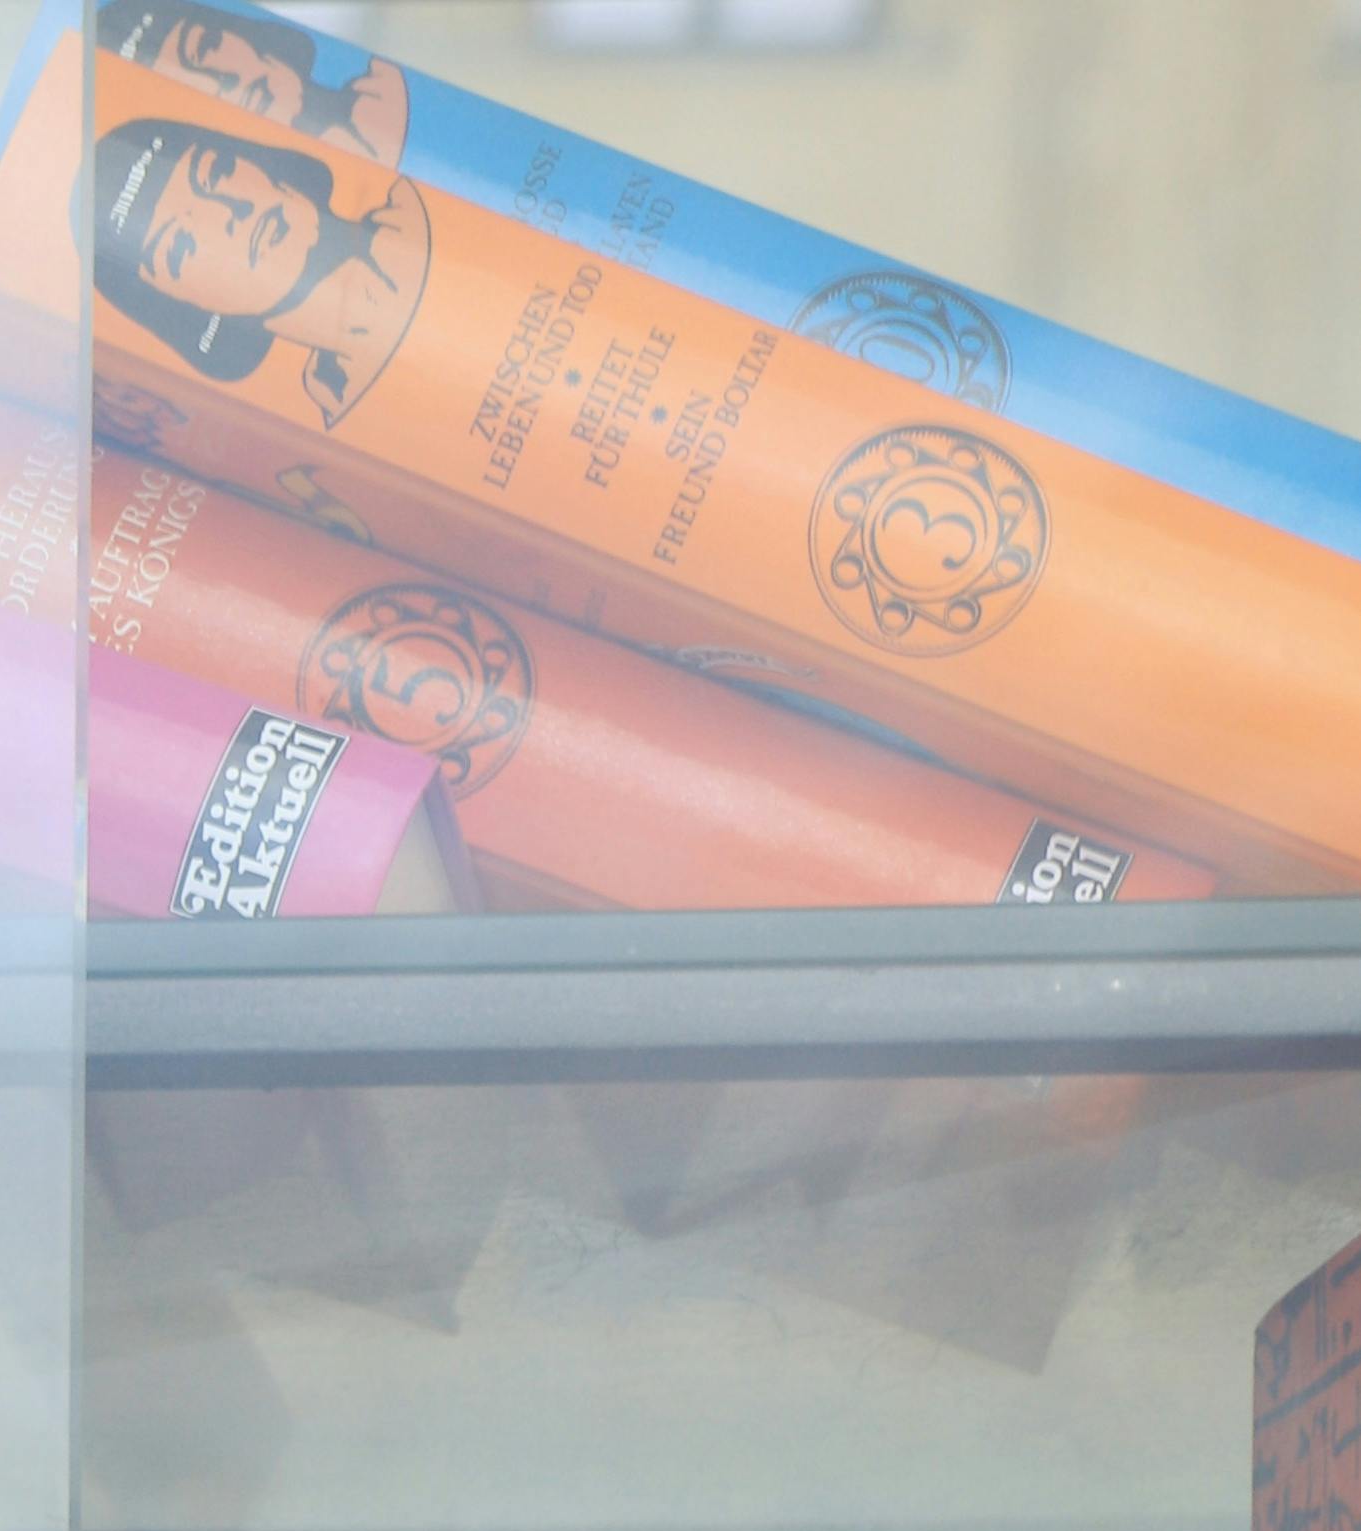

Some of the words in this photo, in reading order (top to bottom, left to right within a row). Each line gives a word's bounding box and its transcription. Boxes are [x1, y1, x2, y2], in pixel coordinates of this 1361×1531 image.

[469, 283, 556, 441] ZWISCHEN
[484, 401, 535, 491] LEBEN
[523, 336, 566, 404] UND
[559, 264, 602, 326] TOD
[654, 434, 724, 565] FREUND
[719, 330, 780, 430] BOLTAR
[177, 716, 294, 913] Edition
[231, 730, 335, 919] Aktuell
